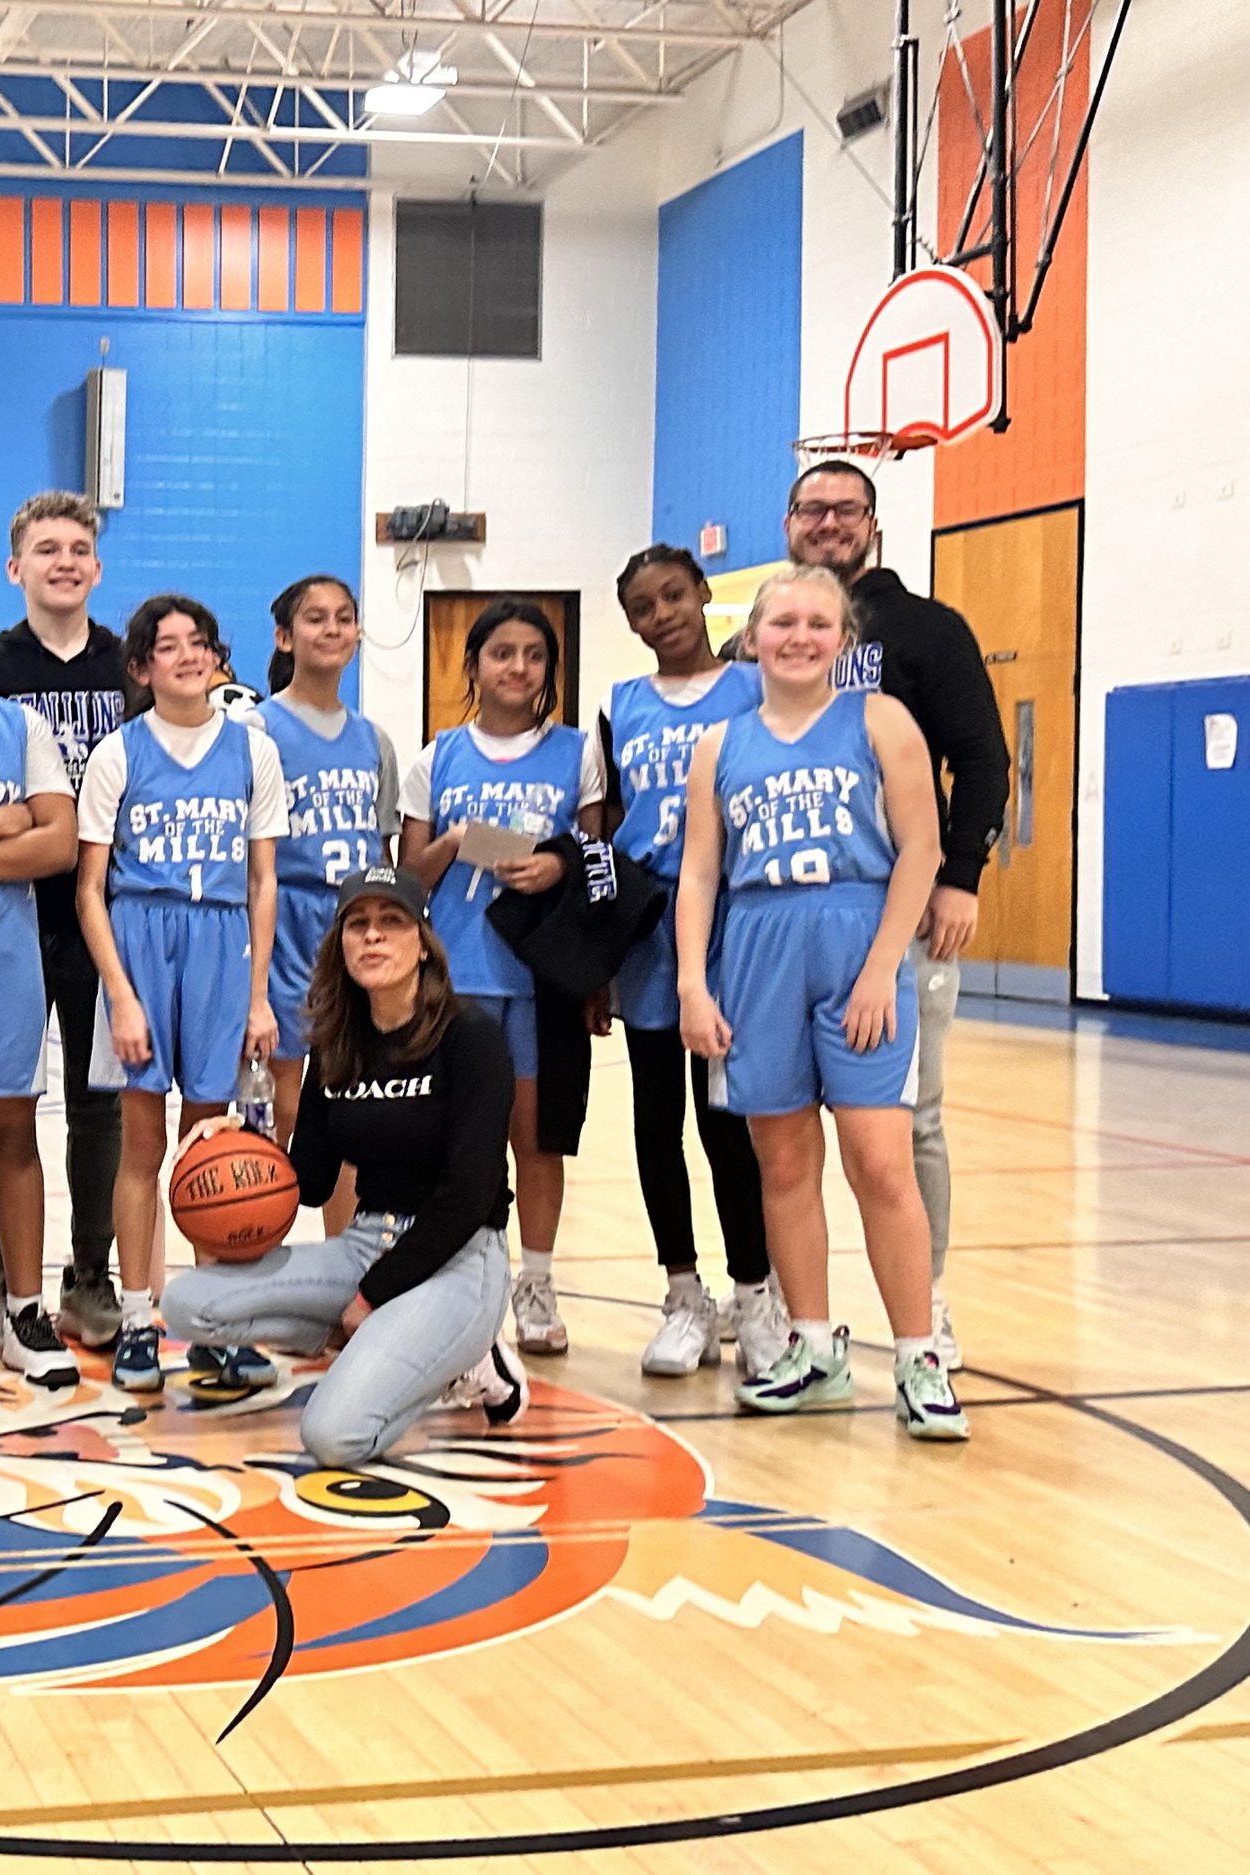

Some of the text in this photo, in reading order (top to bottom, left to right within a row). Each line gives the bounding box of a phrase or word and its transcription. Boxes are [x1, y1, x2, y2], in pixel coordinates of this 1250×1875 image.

[621, 733, 655, 769] ST.
[662, 723, 705, 746] MA
[648, 746, 671, 763] OF
[629, 760, 689, 793] MIL
[312, 790, 364, 808] OF THE
[440, 784, 475, 817] ST.
[467, 802, 485, 816] OF
[729, 765, 860, 830] ST. MARY
[758, 791, 824, 821] OF THE
[130, 797, 249, 835] ST. MARY
[165, 819, 225, 837] OF THE
[742, 805, 853, 857] MILLS
[138, 835, 245, 864] MILLS
[322, 838, 368, 886] 21
[189, 863, 203, 902] 1
